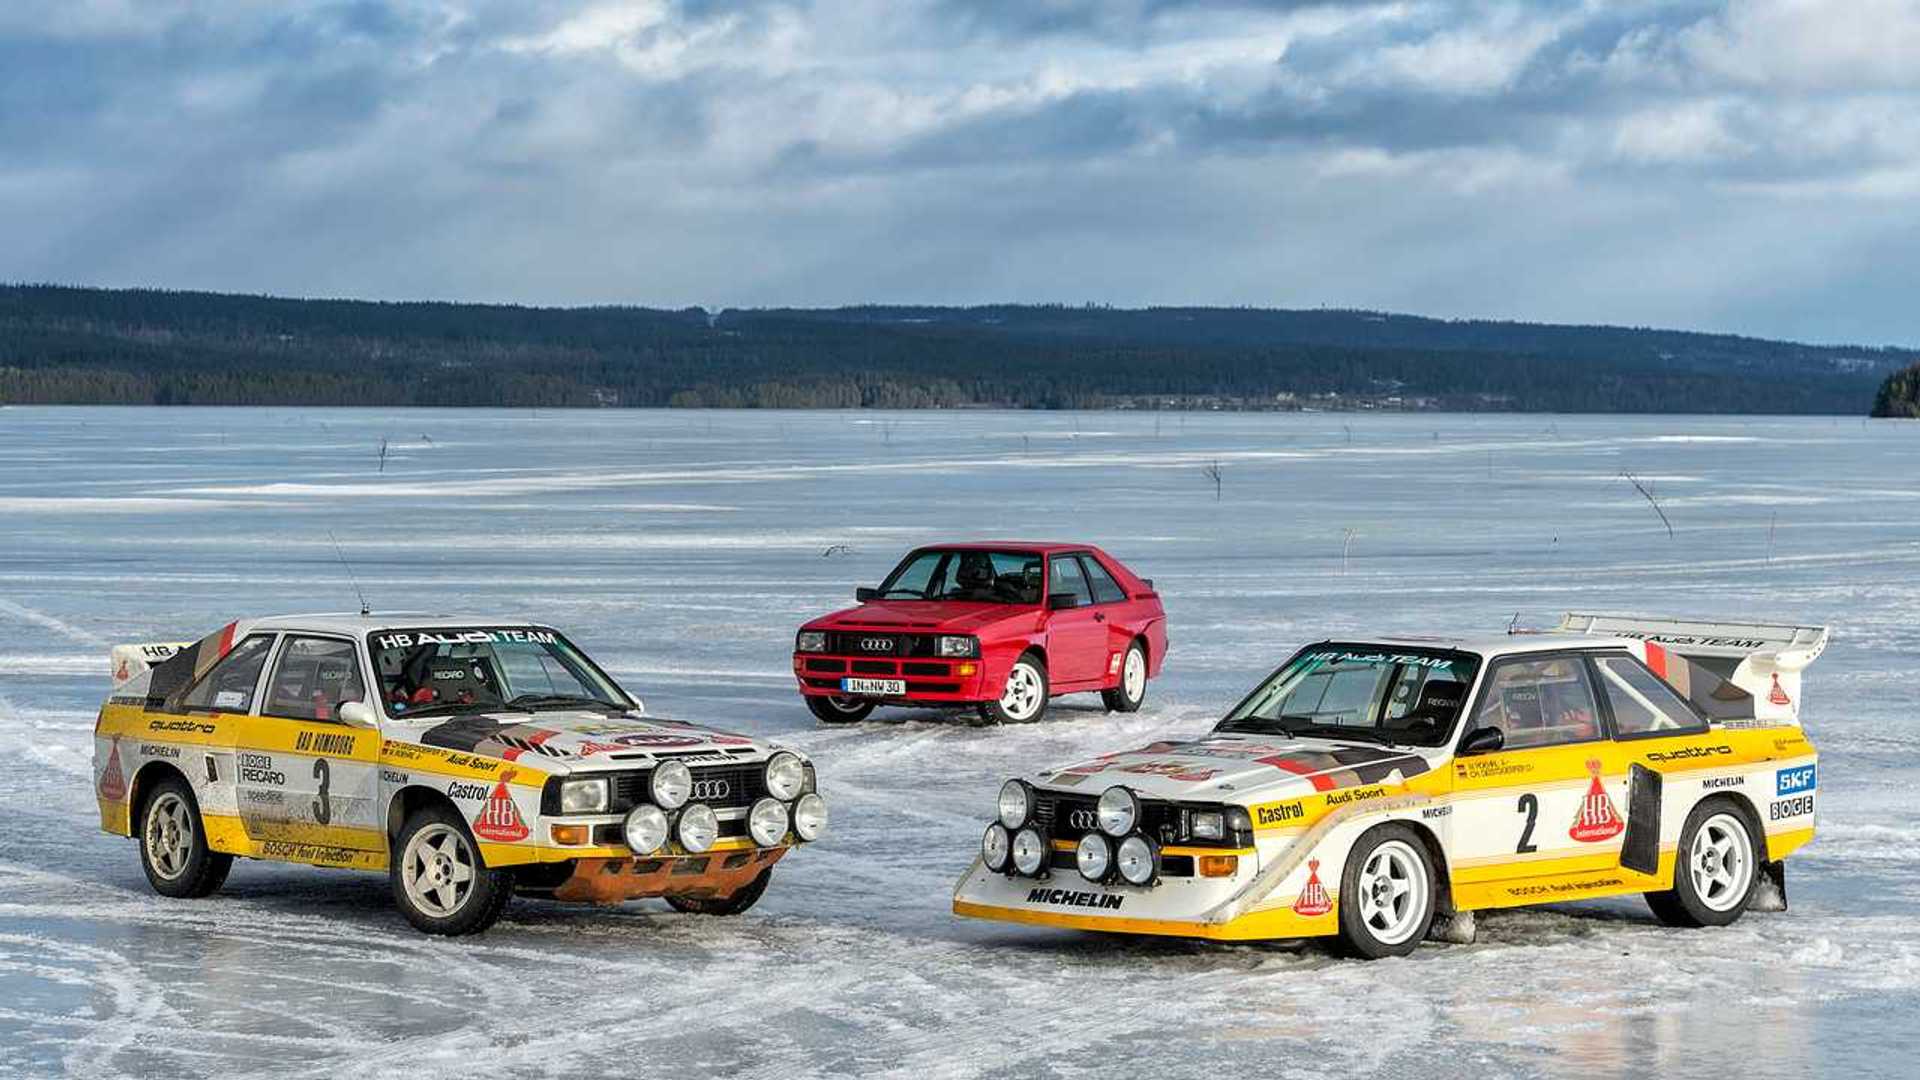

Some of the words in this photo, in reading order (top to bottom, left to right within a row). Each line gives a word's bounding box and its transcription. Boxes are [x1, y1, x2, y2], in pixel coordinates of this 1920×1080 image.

[378, 634, 413, 649] HB
[496, 630, 558, 645] TEAM
[142, 646, 172, 656] HB
[1388, 654, 1453, 669] TEAM
[886, 682, 900, 693] 30
[150, 720, 216, 734] quattro
[296, 730, 314, 751] BAD
[140, 744, 181, 758] MICHELIN
[1646, 745, 1733, 764] quattro
[446, 753, 471, 766] Audi
[468, 757, 499, 772] Sport
[242, 768, 286, 786] RECARO
[1702, 776, 1745, 789] MICHELIN
[1780, 769, 1813, 790] SKF
[312, 758, 331, 825] 3
[447, 781, 490, 802] Castrol
[1326, 791, 1353, 806] Audi
[1353, 788, 1386, 801] Sport
[486, 799, 515, 827] HB
[1257, 801, 1305, 825] Castrol
[1582, 793, 1611, 826] HB
[1770, 796, 1814, 821] BOGE
[1516, 793, 1539, 854] 2
[1026, 888, 1124, 909] MICHELIN
